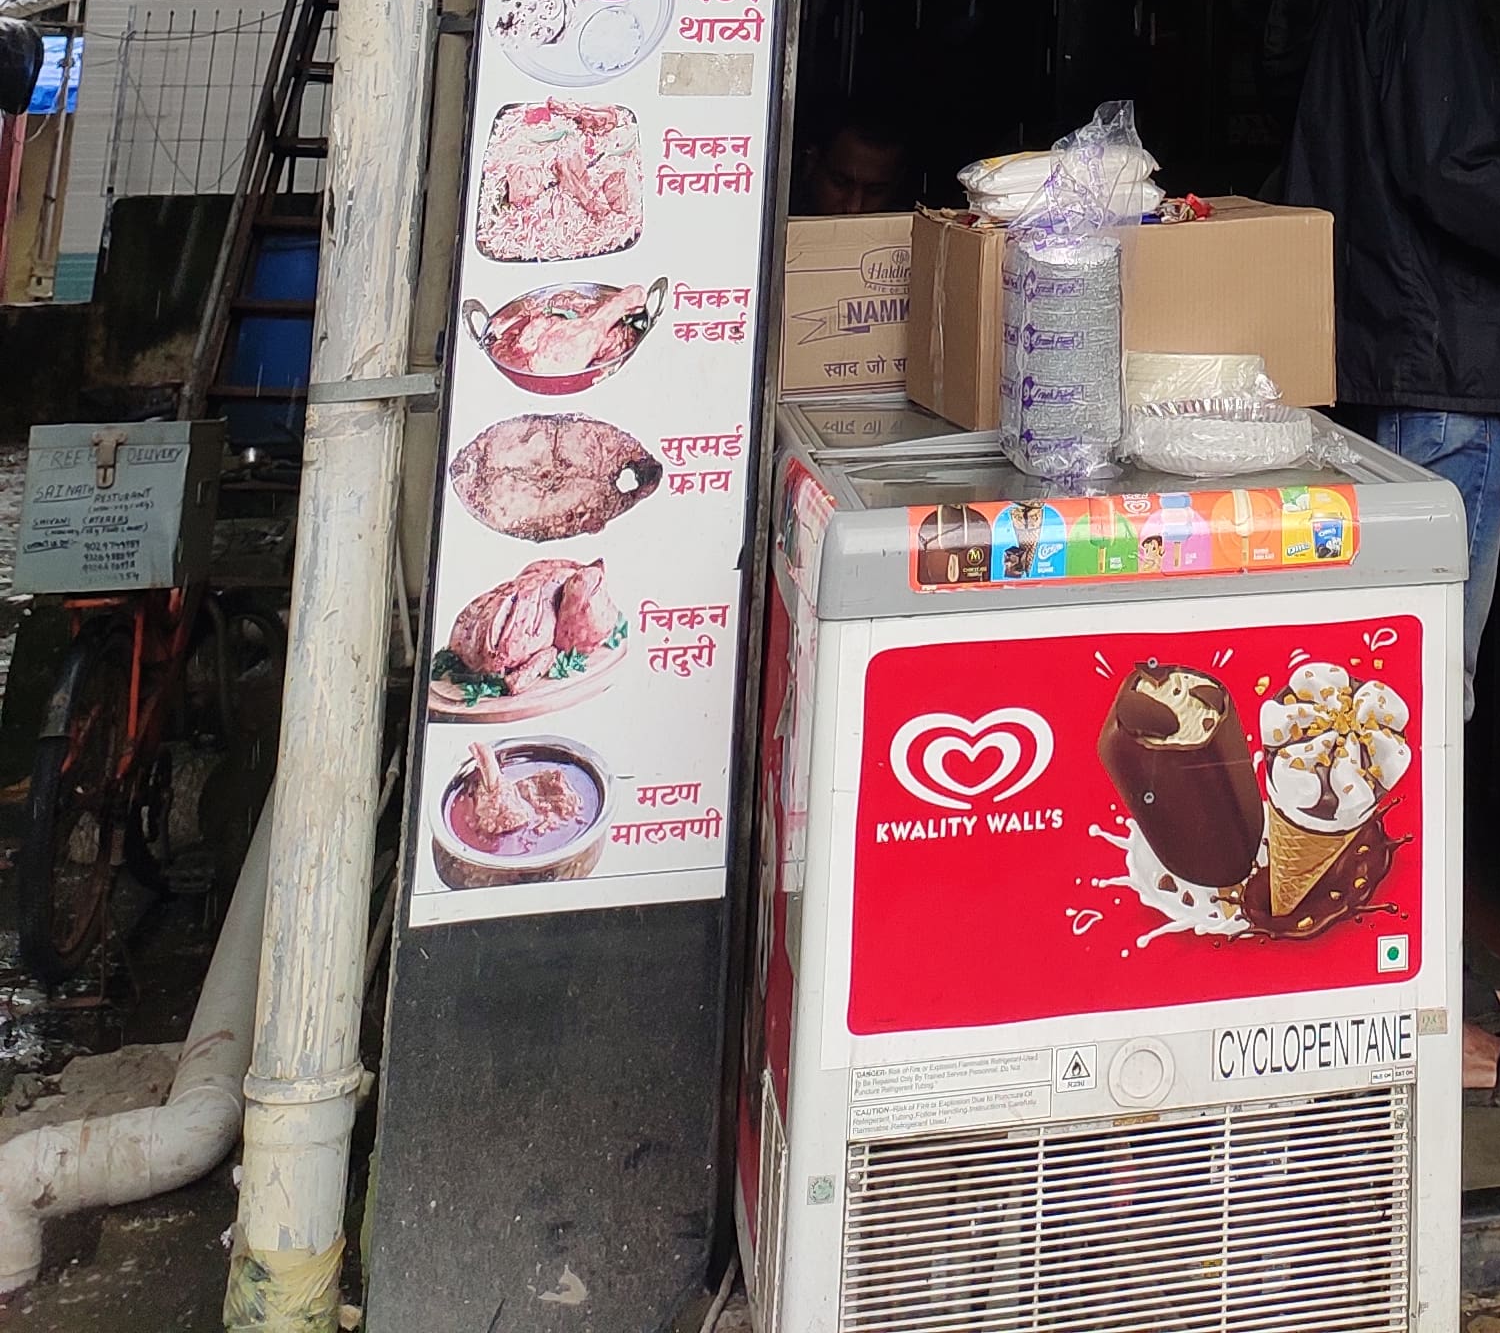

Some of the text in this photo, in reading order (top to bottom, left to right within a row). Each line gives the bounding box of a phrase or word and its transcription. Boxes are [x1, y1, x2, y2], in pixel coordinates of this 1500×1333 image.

[679, 14, 765, 44] थाळी
[662, 128, 750, 160] चिकन
[868, 262, 911, 280] Haldir
[672, 283, 749, 310] चिकन
[673, 313, 748, 346] कडाई
[824, 362, 859, 377] स्वाद
[867, 355, 887, 373] जो
[661, 424, 744, 466] सुरमई
[639, 601, 730, 633] चिकन
[637, 782, 702, 809] मटण
[610, 810, 723, 848] मालवणी
[876, 809, 1064, 844] KWALITY WALL'S
[1218, 1013, 1413, 1079] CYCLOPENTANE
